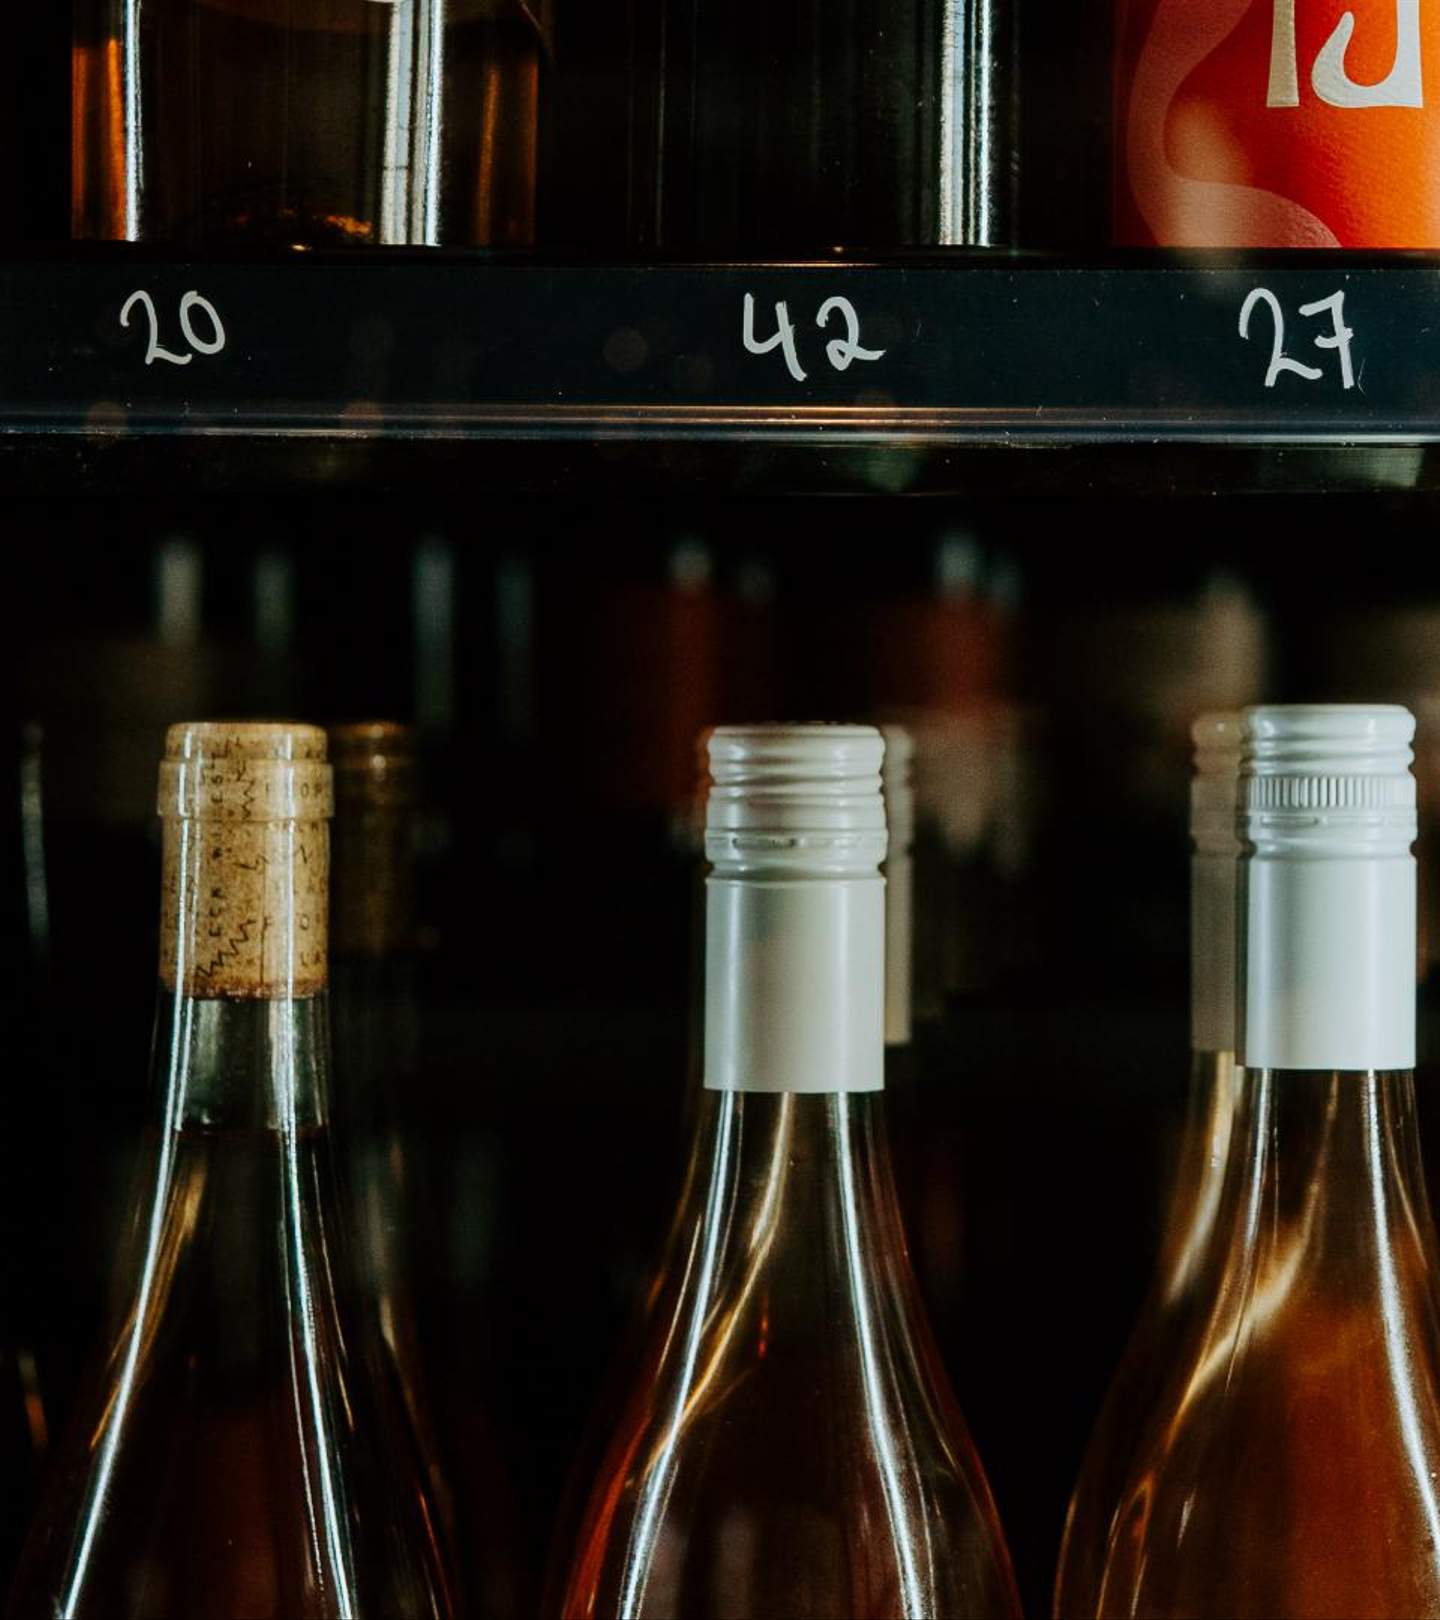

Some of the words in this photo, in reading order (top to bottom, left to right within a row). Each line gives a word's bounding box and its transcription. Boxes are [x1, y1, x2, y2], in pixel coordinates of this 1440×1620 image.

[120, 290, 226, 365] 20
[743, 292, 886, 382] 42
[1238, 287, 1355, 389] 27
